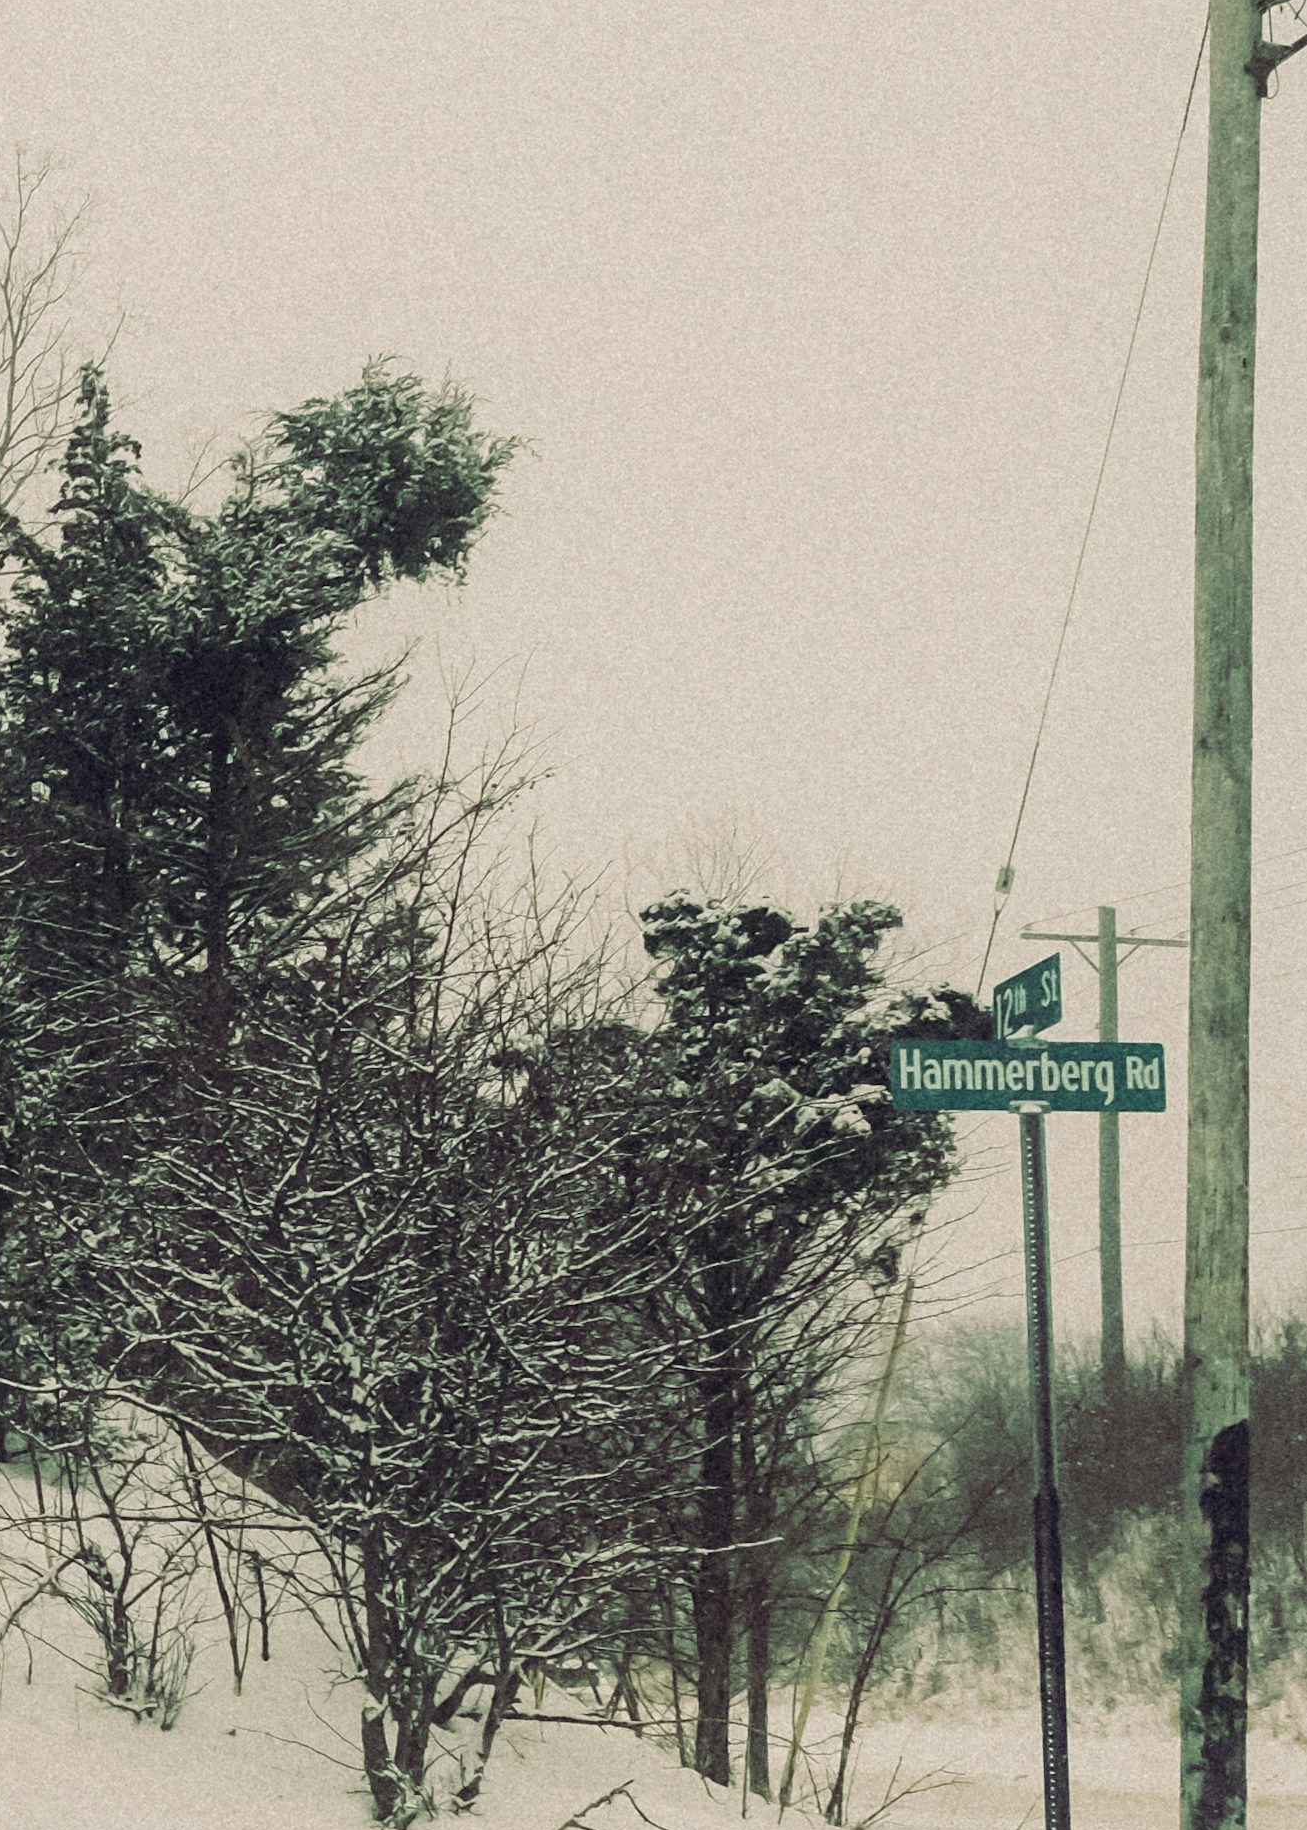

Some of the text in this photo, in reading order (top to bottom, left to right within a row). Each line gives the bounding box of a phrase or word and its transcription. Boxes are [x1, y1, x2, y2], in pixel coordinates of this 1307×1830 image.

[996, 967, 1058, 1039] 12th St
[898, 1047, 1160, 1106] Hammerberg Rd
